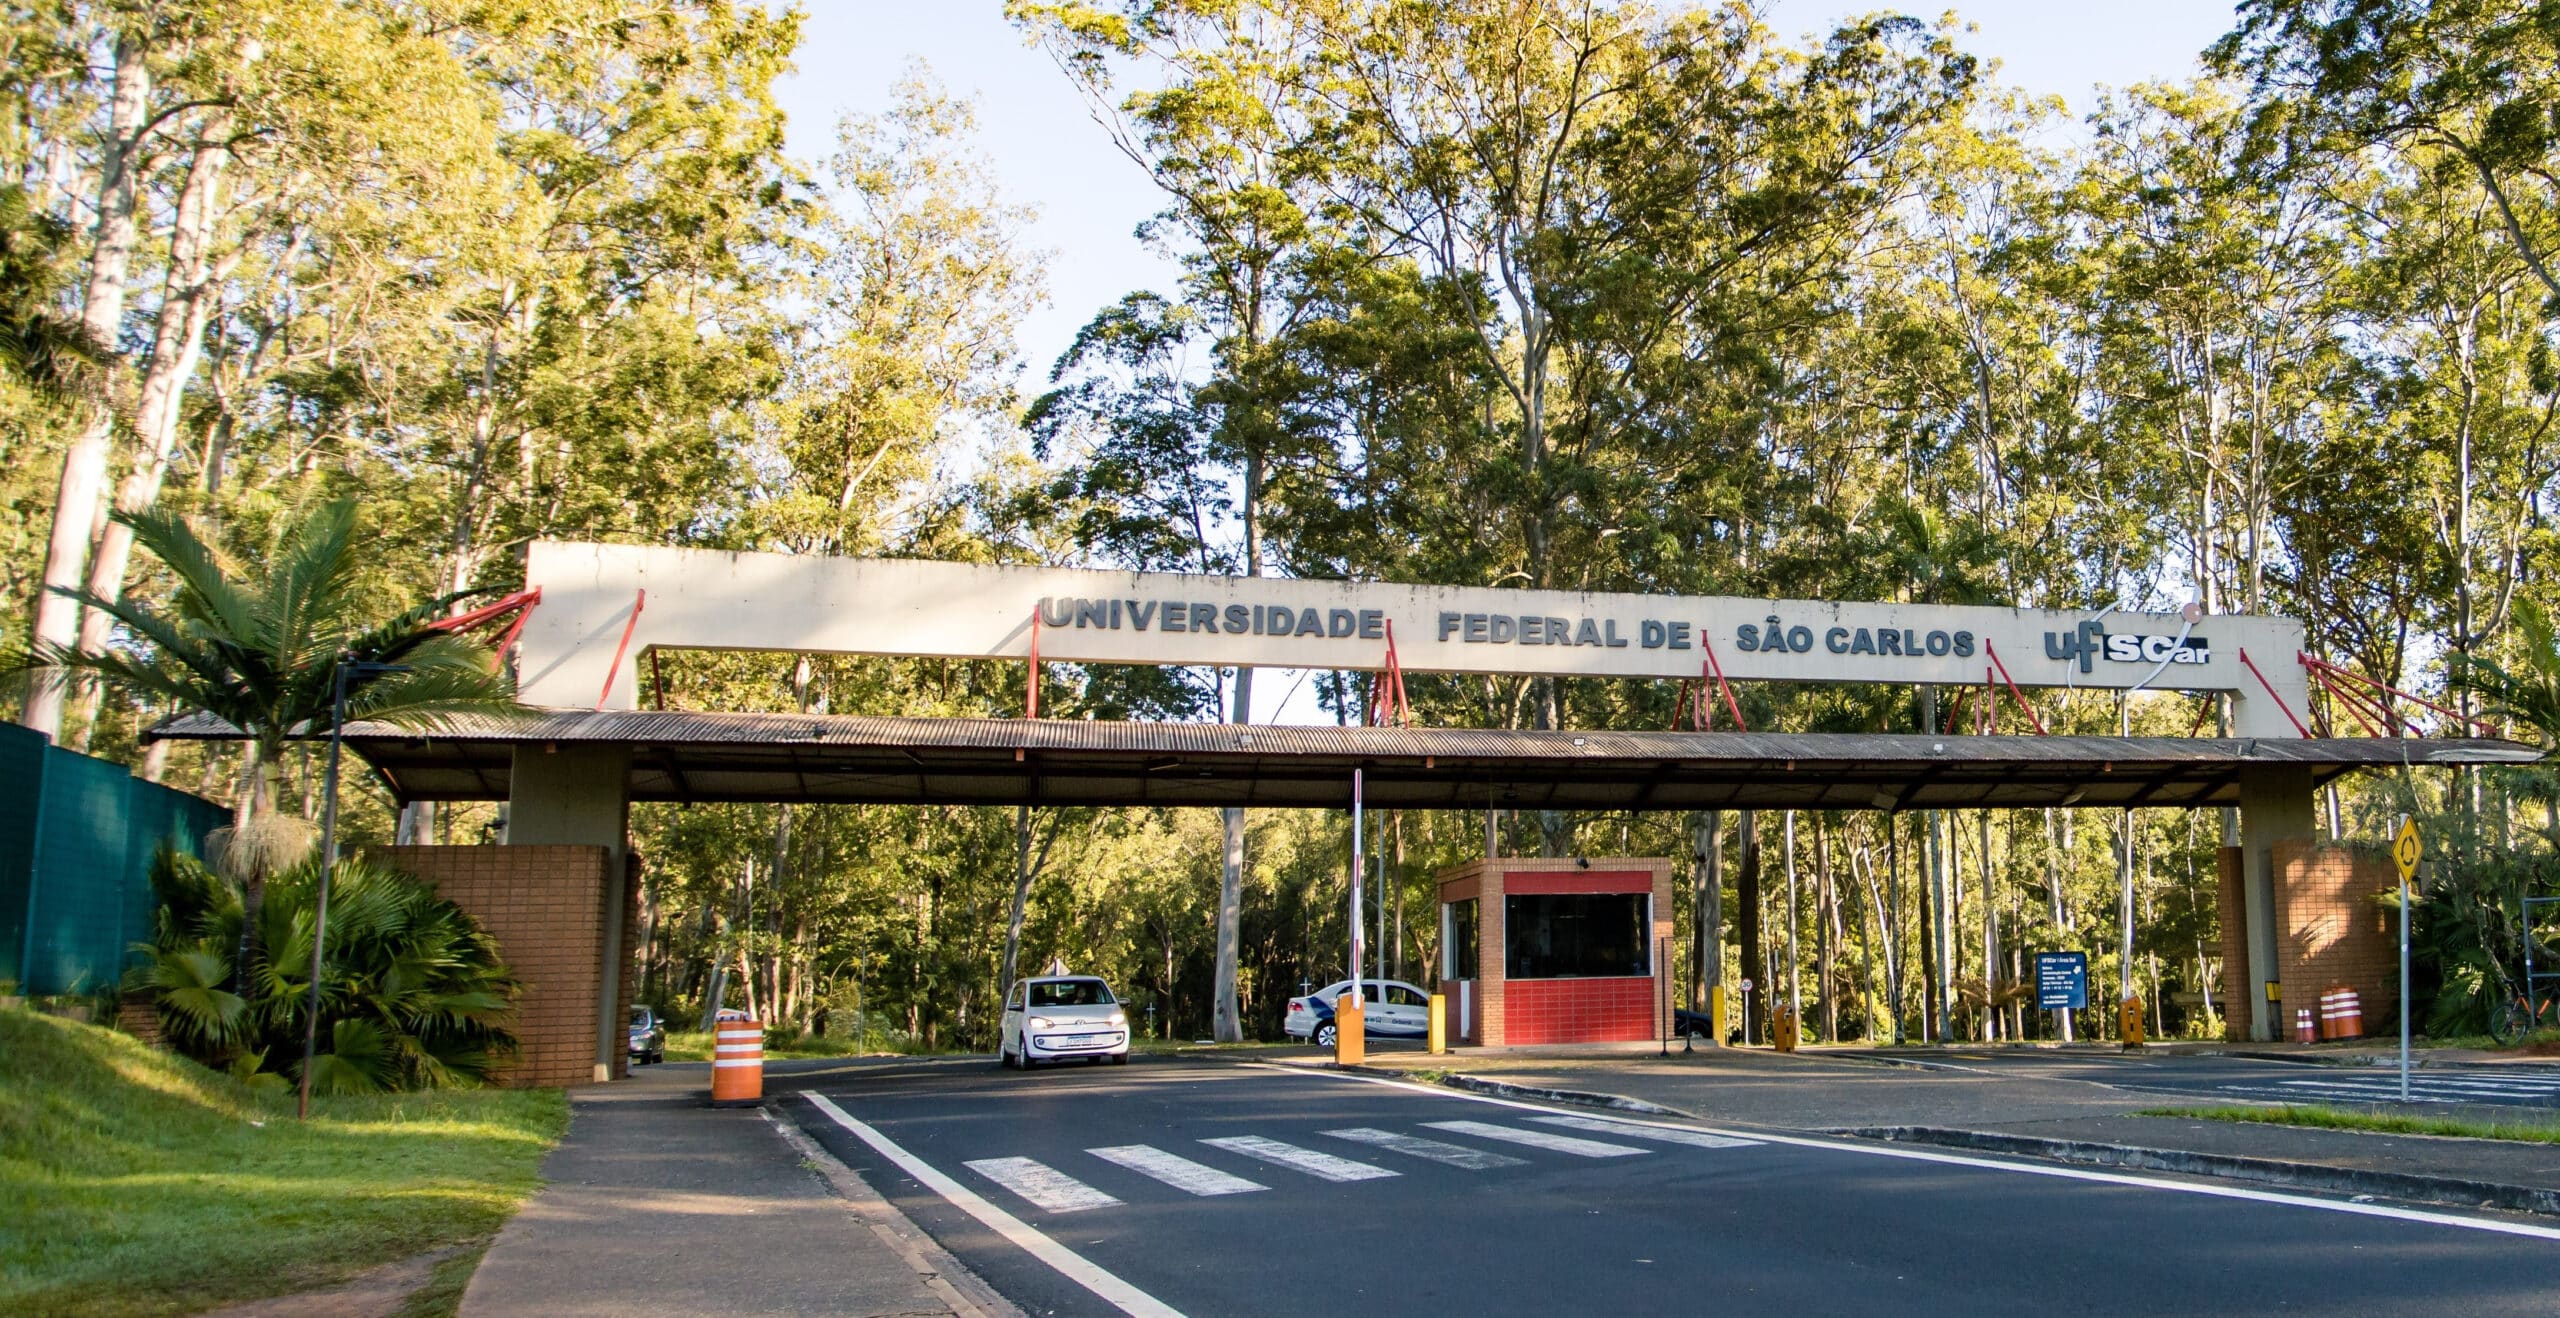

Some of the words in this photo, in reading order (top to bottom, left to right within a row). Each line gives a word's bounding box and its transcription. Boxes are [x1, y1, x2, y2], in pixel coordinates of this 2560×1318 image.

[1040, 597, 1384, 638] UNIVERSIDADE
[1438, 611, 1628, 647] FEDERAL
[1641, 620, 1691, 649] DE
[1736, 615, 1814, 652] SÃO
[1825, 627, 1975, 657] CARLOS
